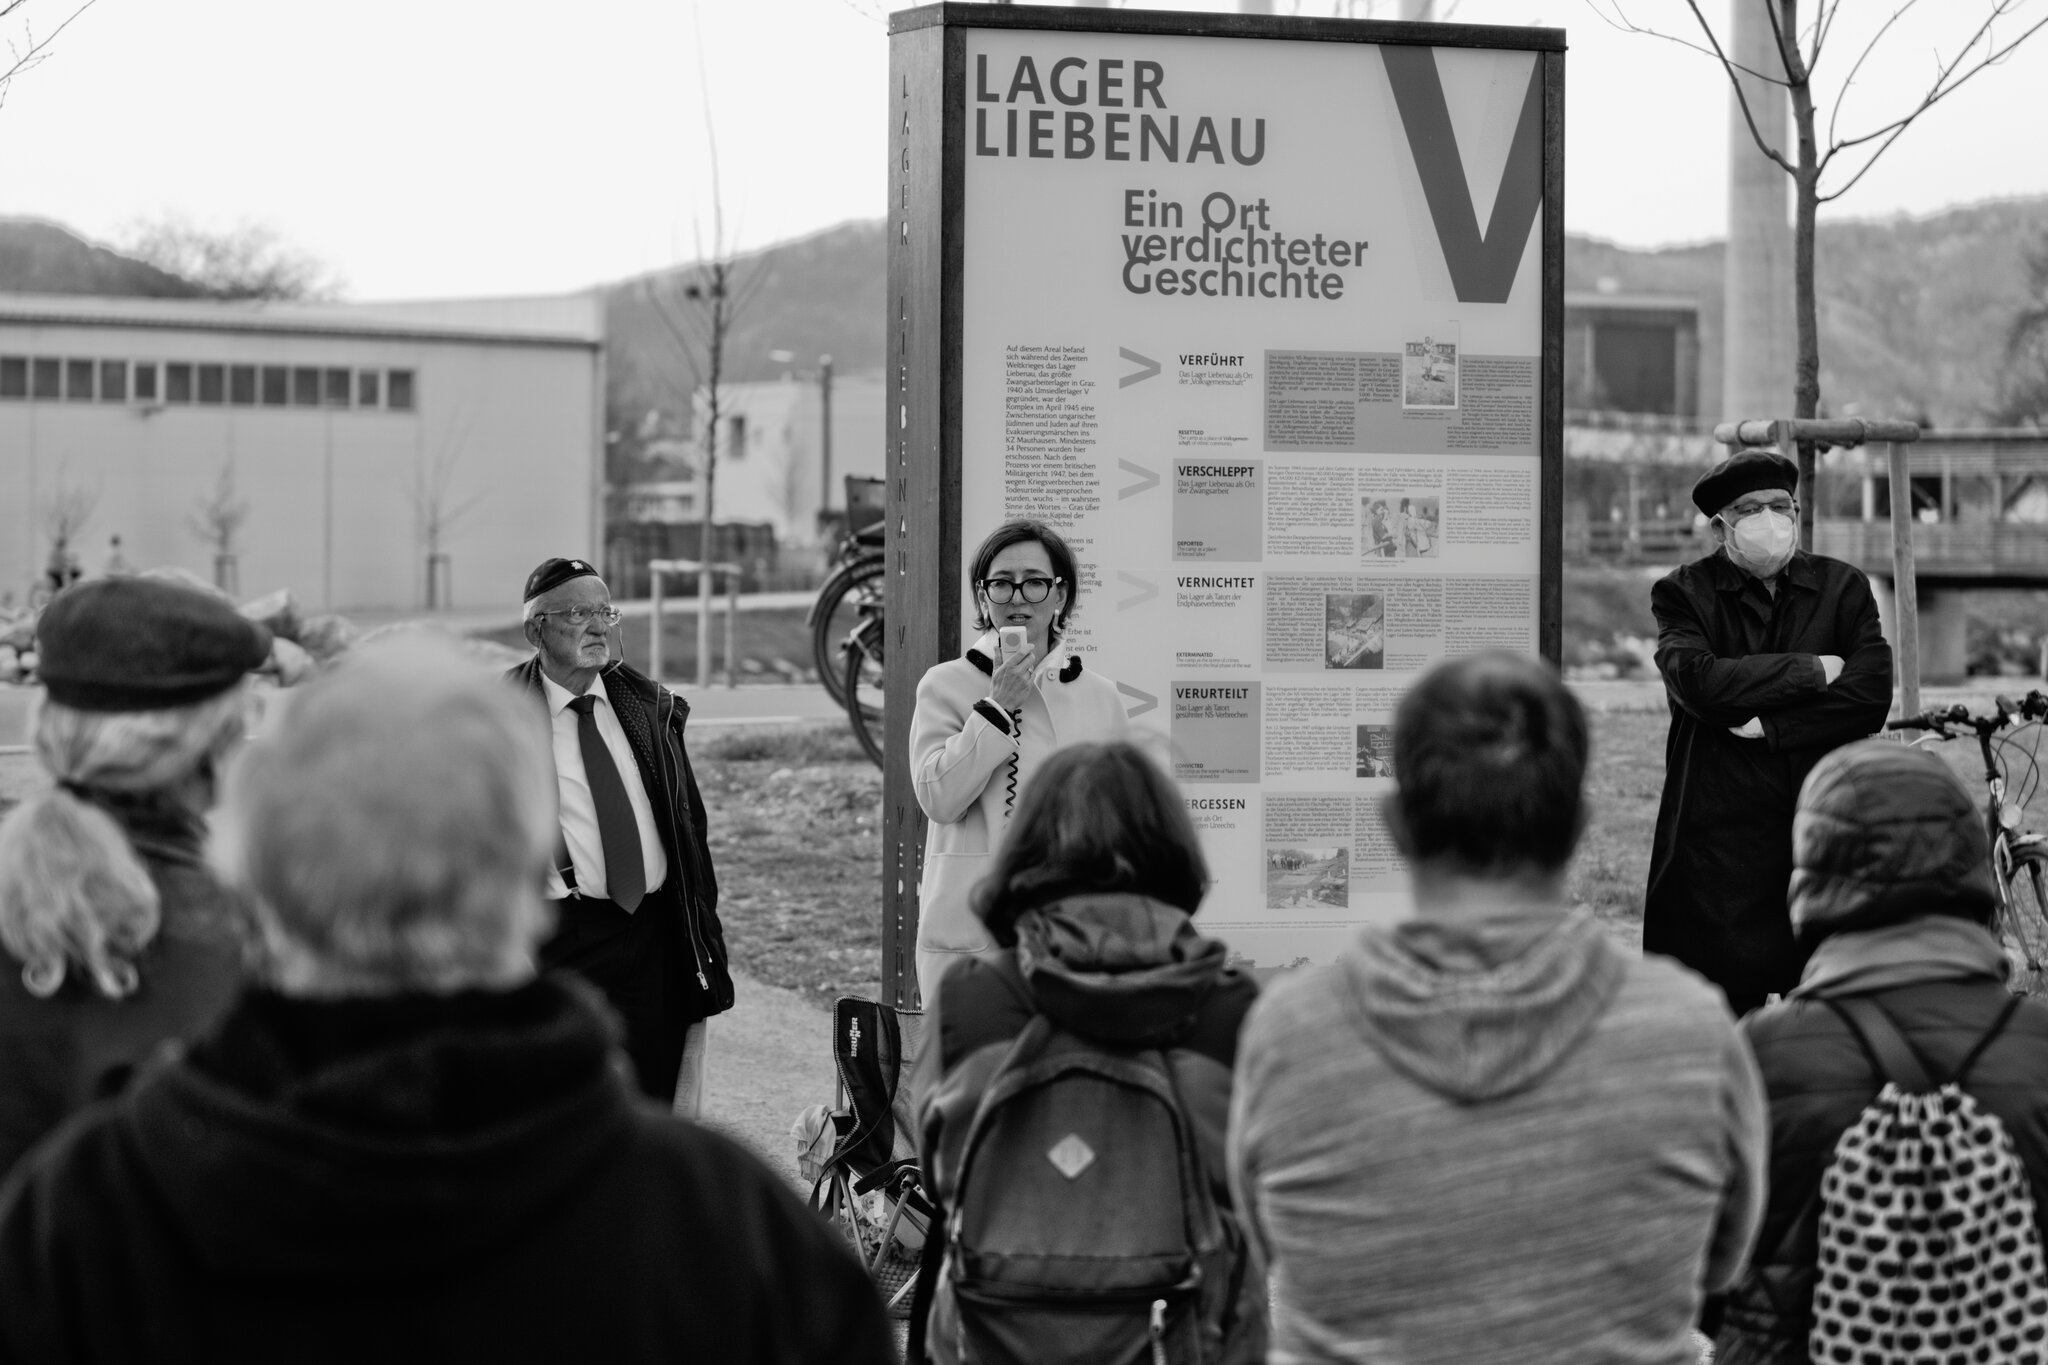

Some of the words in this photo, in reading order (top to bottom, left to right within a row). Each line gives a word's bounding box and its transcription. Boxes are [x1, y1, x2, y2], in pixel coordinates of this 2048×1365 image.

[975, 53, 1167, 109] LAGER
[975, 108, 1267, 166] LIEBENAU
[1376, 44, 1543, 303] V
[1124, 189, 1183, 228] Ein
[1201, 191, 1270, 231] Ort
[1121, 224, 1368, 267] verdichteter
[1122, 256, 1344, 300] Geschichte
[1179, 353, 1244, 366] VERFÜHRT
[1007, 362, 1044, 370] Weltkrieges
[1191, 371, 1206, 379] Lager
[1006, 378, 1069, 387] Zwangsarbeiterlager
[1035, 388, 1082, 396] Umsiedlerlager
[1178, 466, 1254, 477] VERSCHLEPPT
[1178, 577, 1254, 588] VERNICHTET
[1176, 688, 1248, 699] VERURTEILT
[1188, 704, 1203, 712] Lager
[1185, 799, 1245, 809] ERGESSEN
[850, 1017, 861, 1057] BRUNNER
